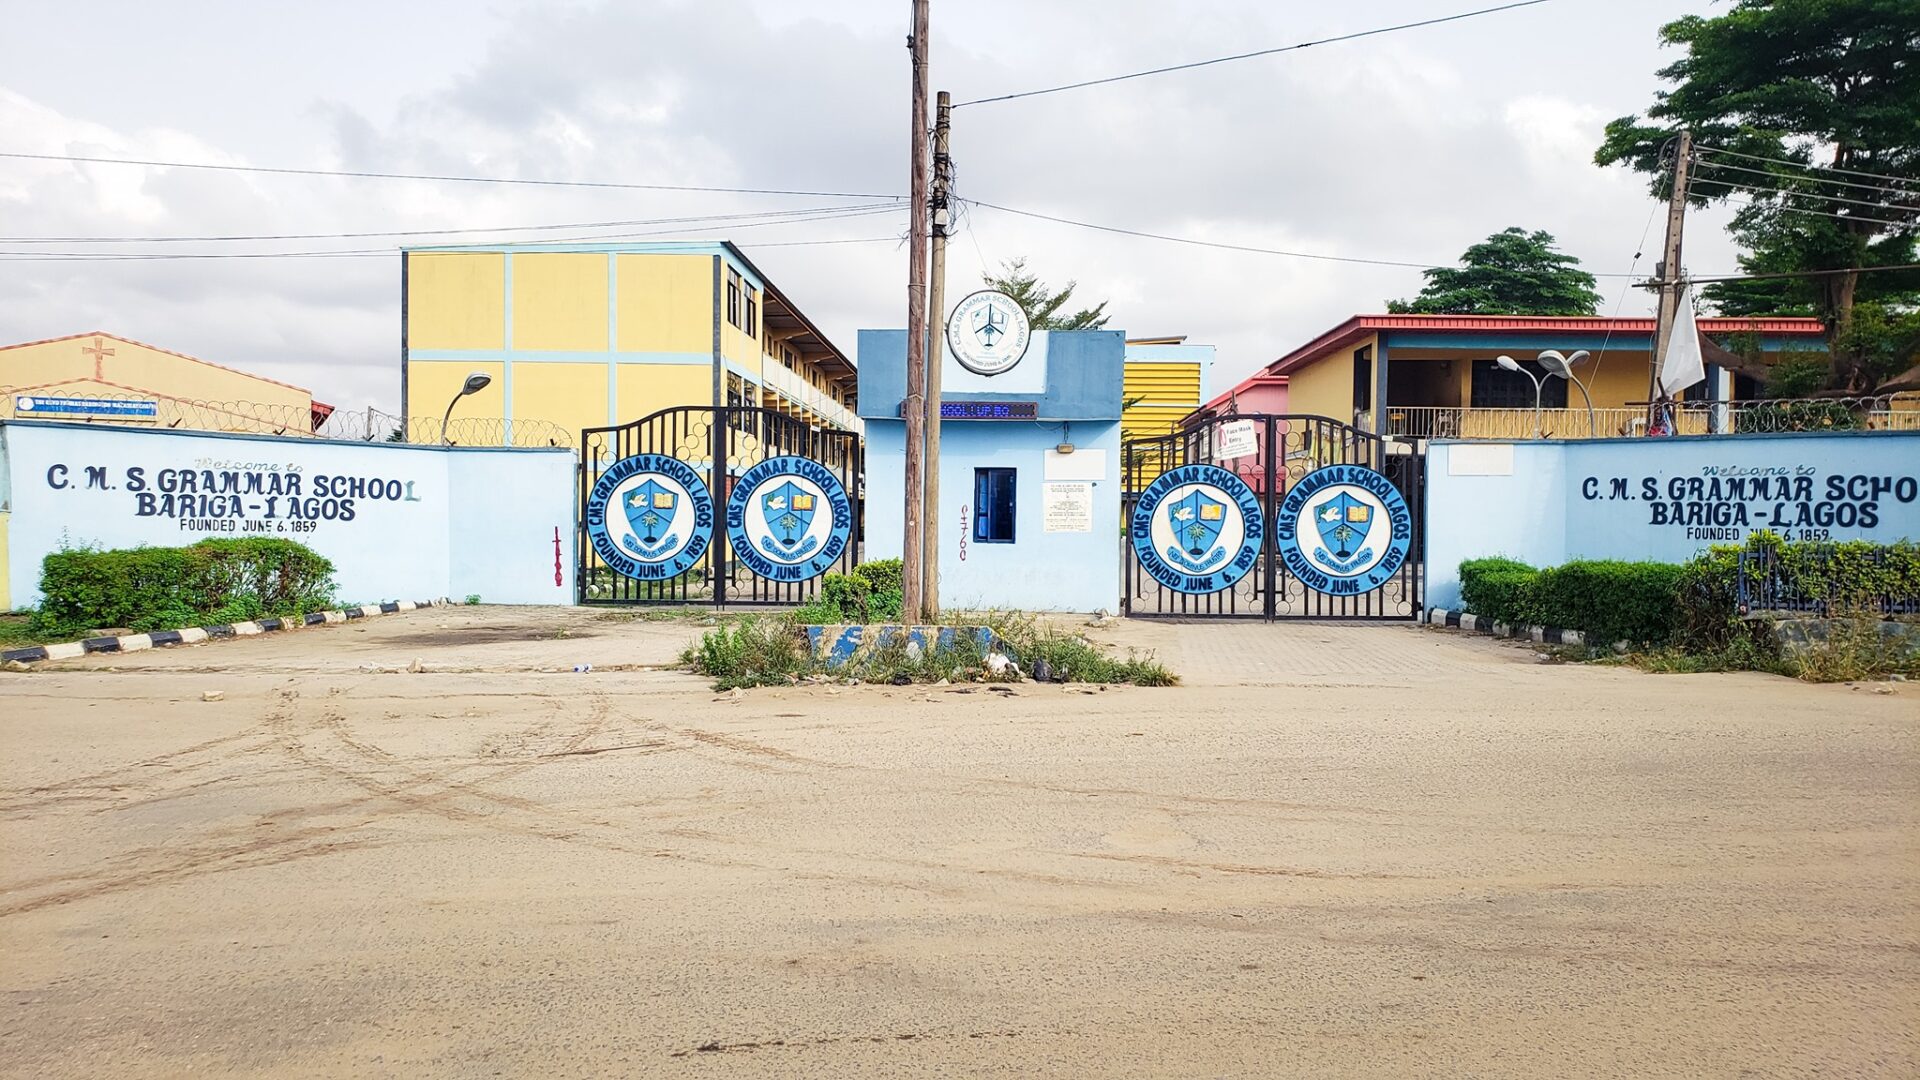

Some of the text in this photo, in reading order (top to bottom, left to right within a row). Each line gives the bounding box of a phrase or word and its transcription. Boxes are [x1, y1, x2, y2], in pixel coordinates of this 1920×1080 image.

[956, 295, 991, 321] GRAMMAR
[1015, 320, 1025, 349] LAGOS
[157, 468, 302, 496] GRAMMAR
[312, 475, 422, 502] SCHOOL
[1668, 476, 1813, 502] GRAMMAR
[1795, 464, 1816, 476] to
[589, 457, 711, 528] CMS GRAMMAR SCHOOL LAGOS
[728, 459, 849, 529] CMS GRAMMAR SCHOOL LAGOS
[1134, 467, 1262, 539] CMS GRAMMAR SCHOOL LAGOS
[1279, 468, 1409, 540] CMS GRAMMAR SCHOOL LAGOS
[180, 519, 236, 531] FOUNDED
[1686, 527, 1740, 540] FOUNDED
[593, 532, 634, 574] FOUNDED
[638, 565, 666, 577] JUNE
[685, 535, 706, 559] 1859
[732, 535, 772, 575] FOUNDED
[774, 566, 801, 579] JUNE
[823, 535, 843, 559] 1859
[1139, 546, 1181, 587] FOUNDED
[1184, 578, 1213, 590] JUNE
[1234, 546, 1255, 570] 1859
[1284, 547, 1328, 589] FOUNDED
[1331, 579, 1359, 593] JUNE
[1381, 547, 1403, 572] 1859
